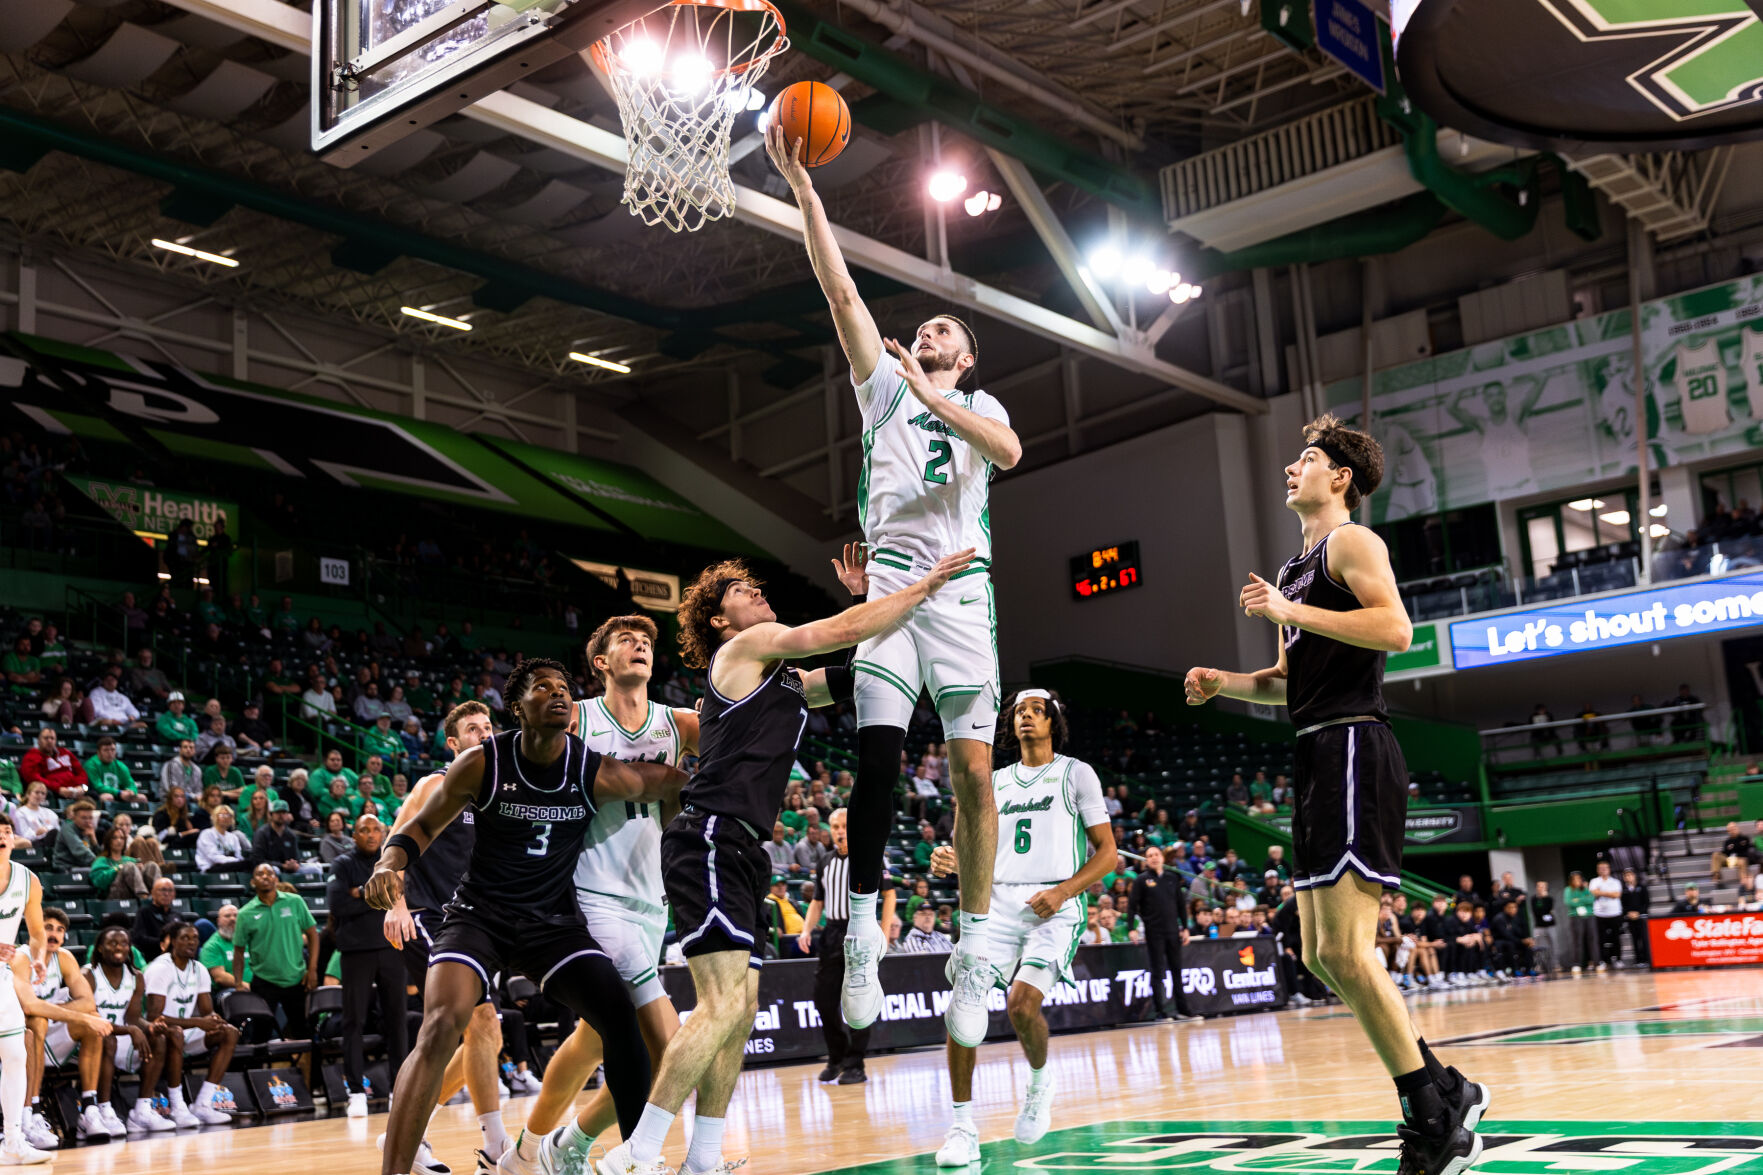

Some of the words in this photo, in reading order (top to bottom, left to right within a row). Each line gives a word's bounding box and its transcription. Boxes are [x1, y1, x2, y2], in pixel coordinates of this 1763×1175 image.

[1688, 375, 1718, 401] 20
[924, 439, 952, 485] 2
[143, 490, 227, 524] Health
[325, 564, 346, 580] 103
[1487, 618, 1564, 656] Let's
[1569, 602, 1668, 644] shout
[793, 706, 809, 751] 7
[499, 801, 587, 822] LIPSCOMB
[998, 795, 1055, 816] Marshall
[526, 821, 553, 857] 3
[1014, 818, 1033, 855] 6
[1089, 978, 1112, 1003] OF
[1222, 966, 1277, 990] Central
